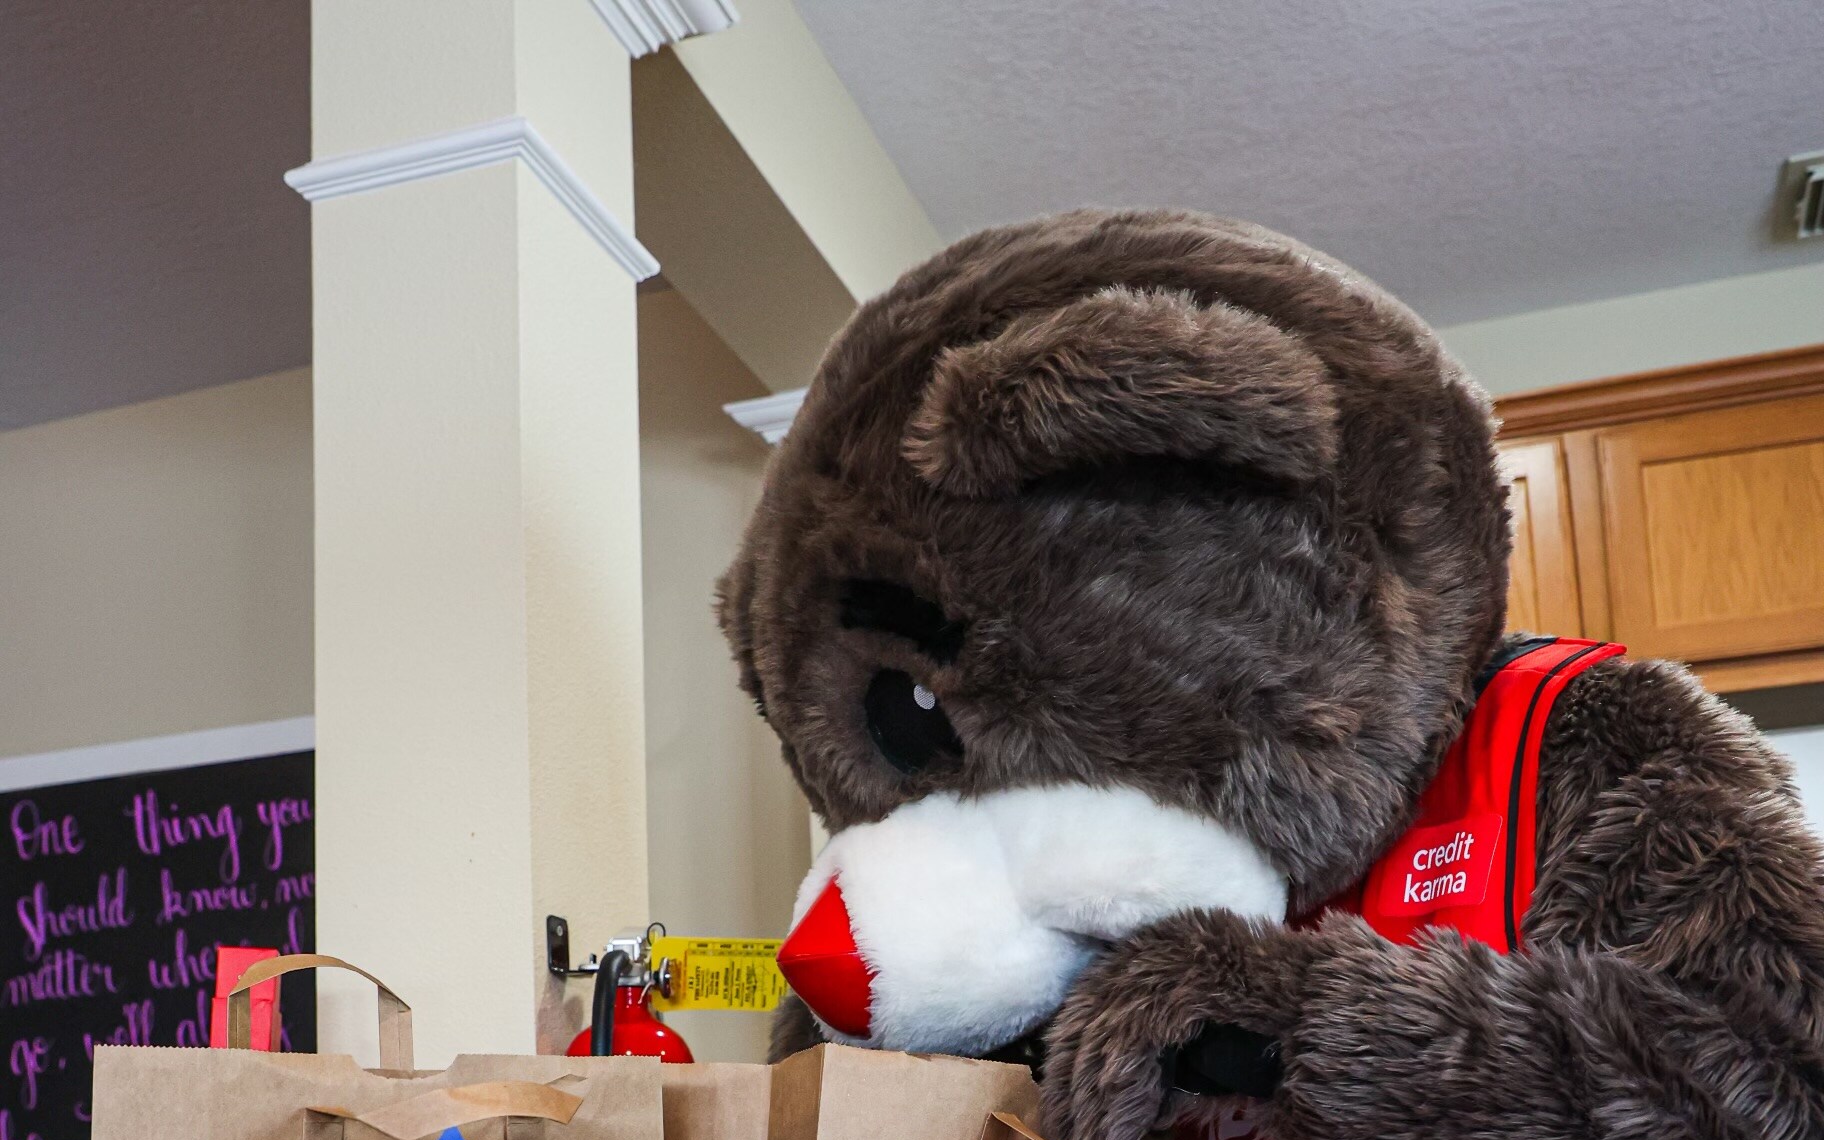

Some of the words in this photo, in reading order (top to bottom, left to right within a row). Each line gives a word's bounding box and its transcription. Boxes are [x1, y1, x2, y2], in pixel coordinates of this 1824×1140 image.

[11, 799, 84, 861] One
[126, 788, 241, 883] thing
[257, 798, 313, 872] you
[1412, 831, 1475, 871] credit
[1403, 871, 1467, 903] karma
[5, 947, 118, 1008] matter
